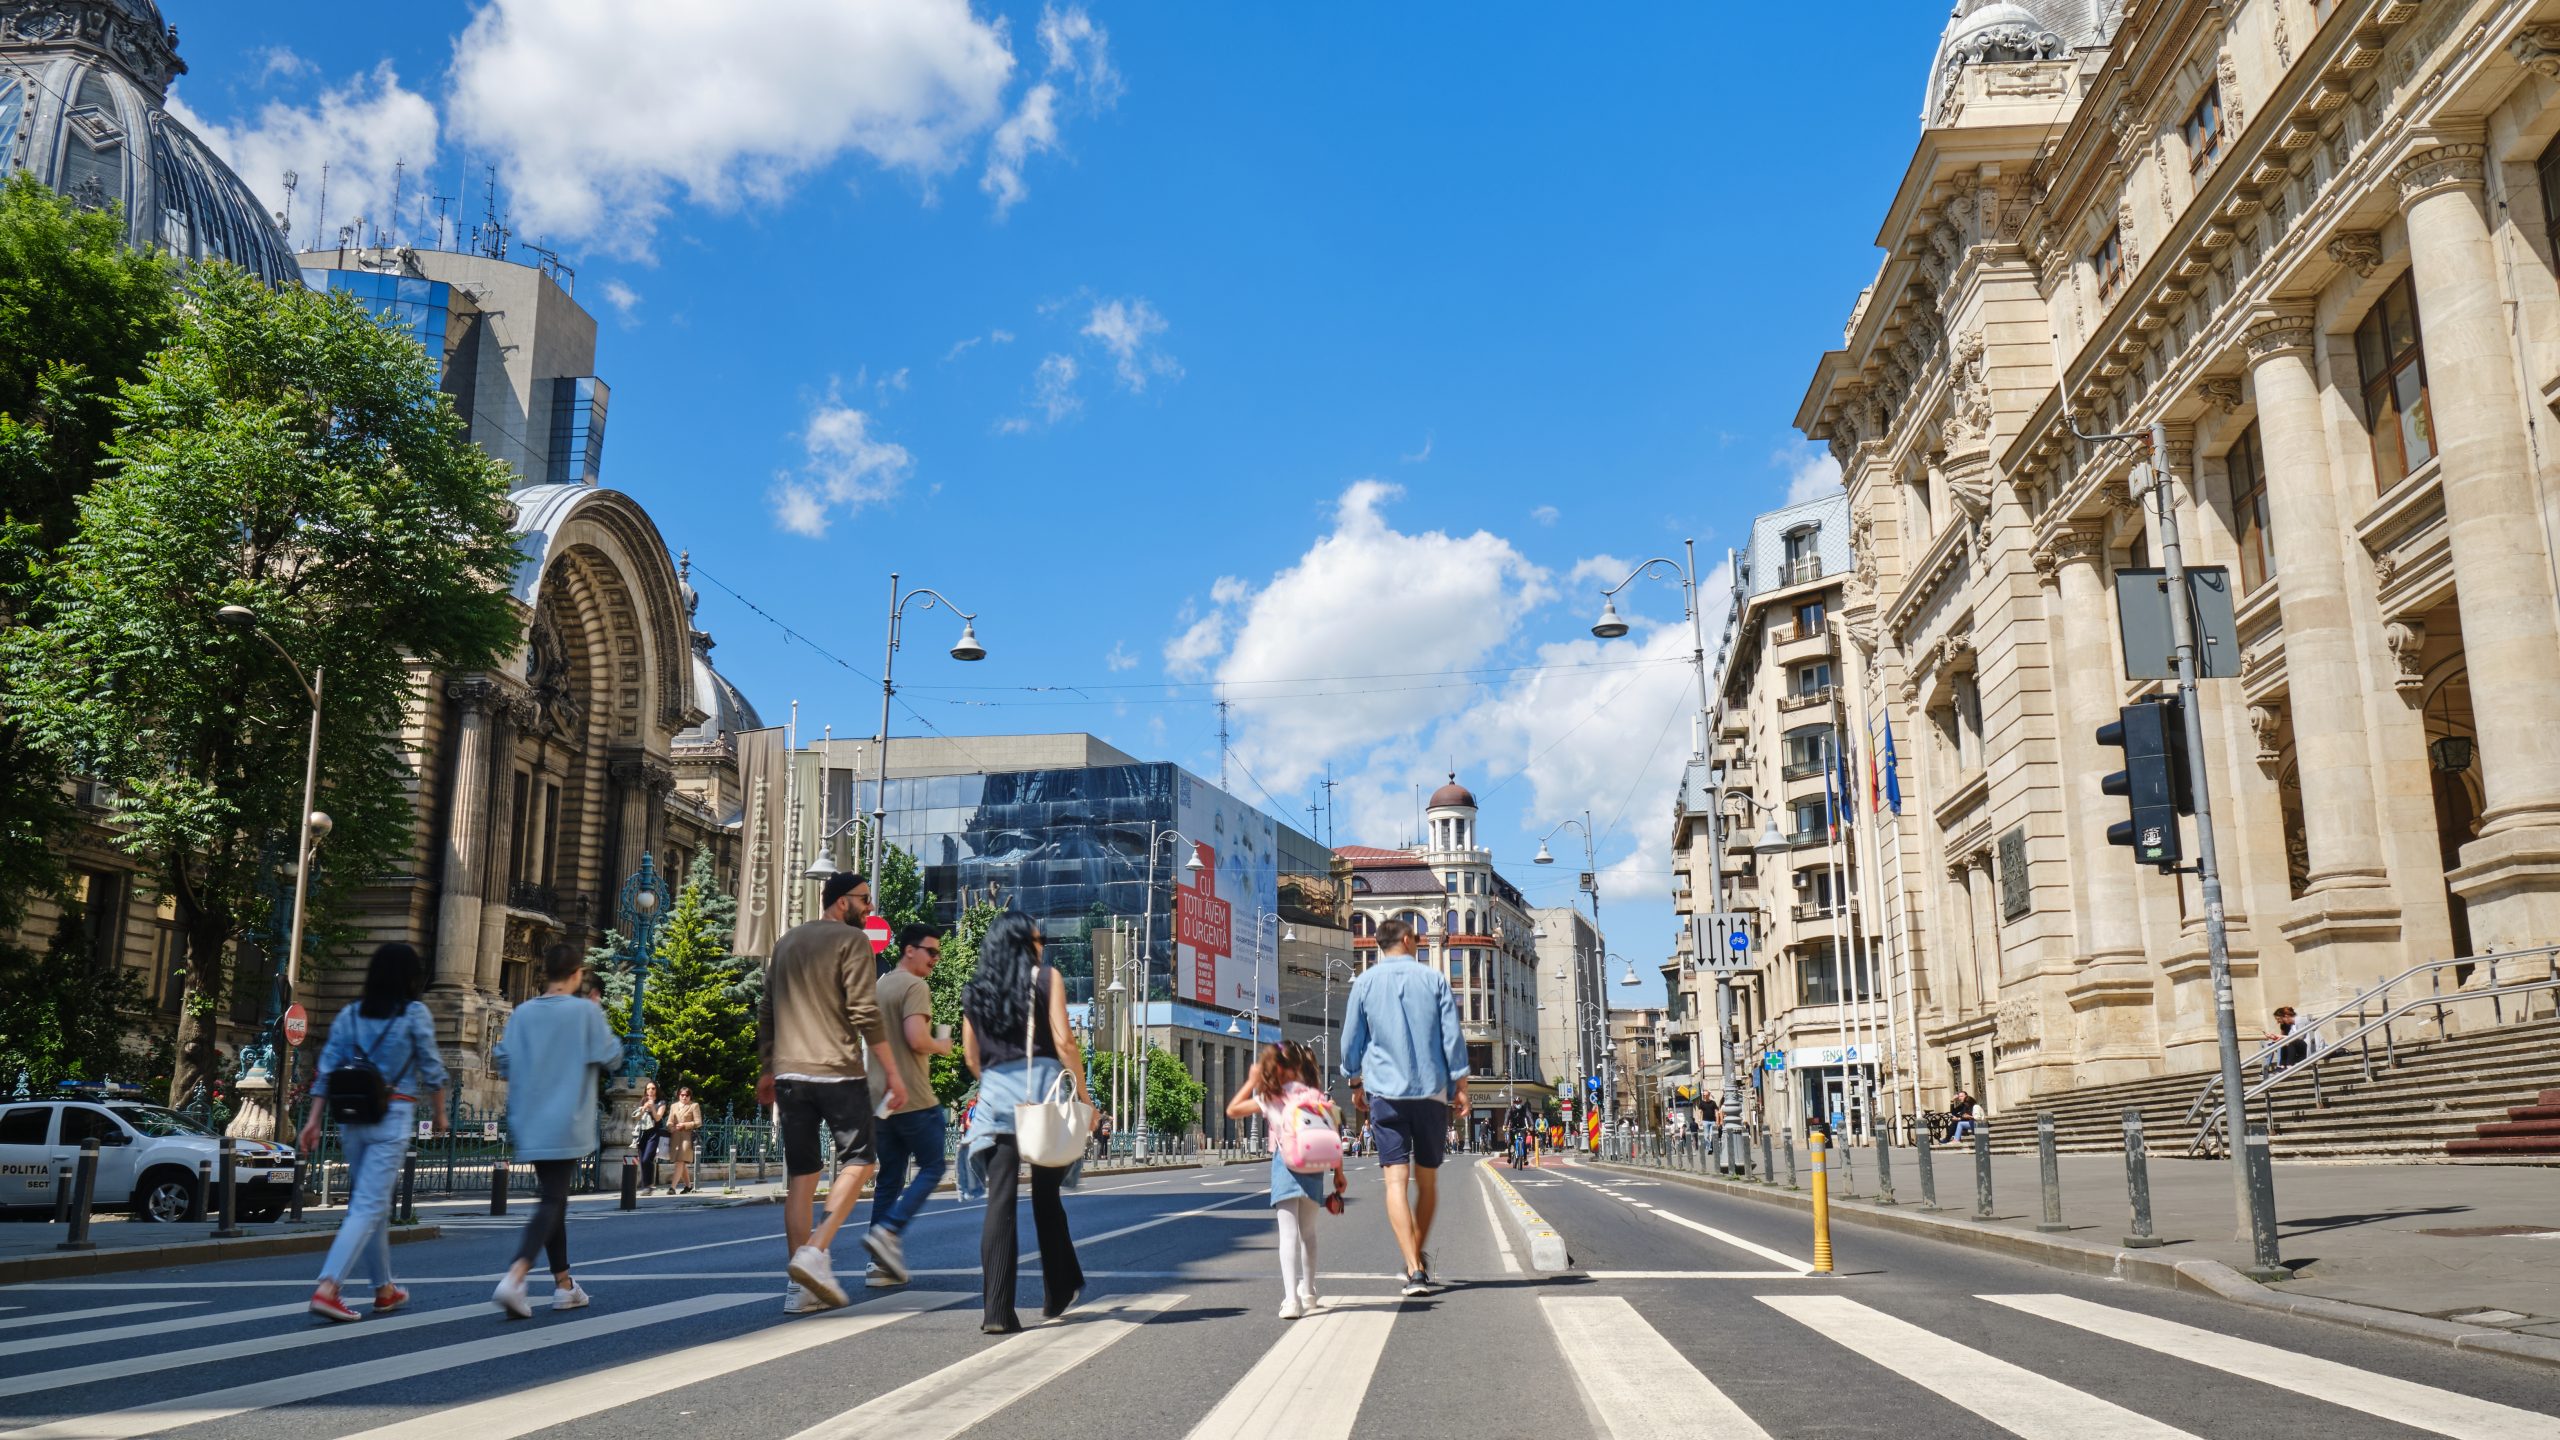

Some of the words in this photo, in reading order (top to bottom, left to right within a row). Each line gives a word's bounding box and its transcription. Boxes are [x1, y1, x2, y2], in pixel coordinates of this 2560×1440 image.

[1200, 875, 1211, 897] CU
[1204, 900, 1226, 925] AVEM
[1183, 917, 1190, 937] O
[1470, 1093, 1491, 1101] TORIA
